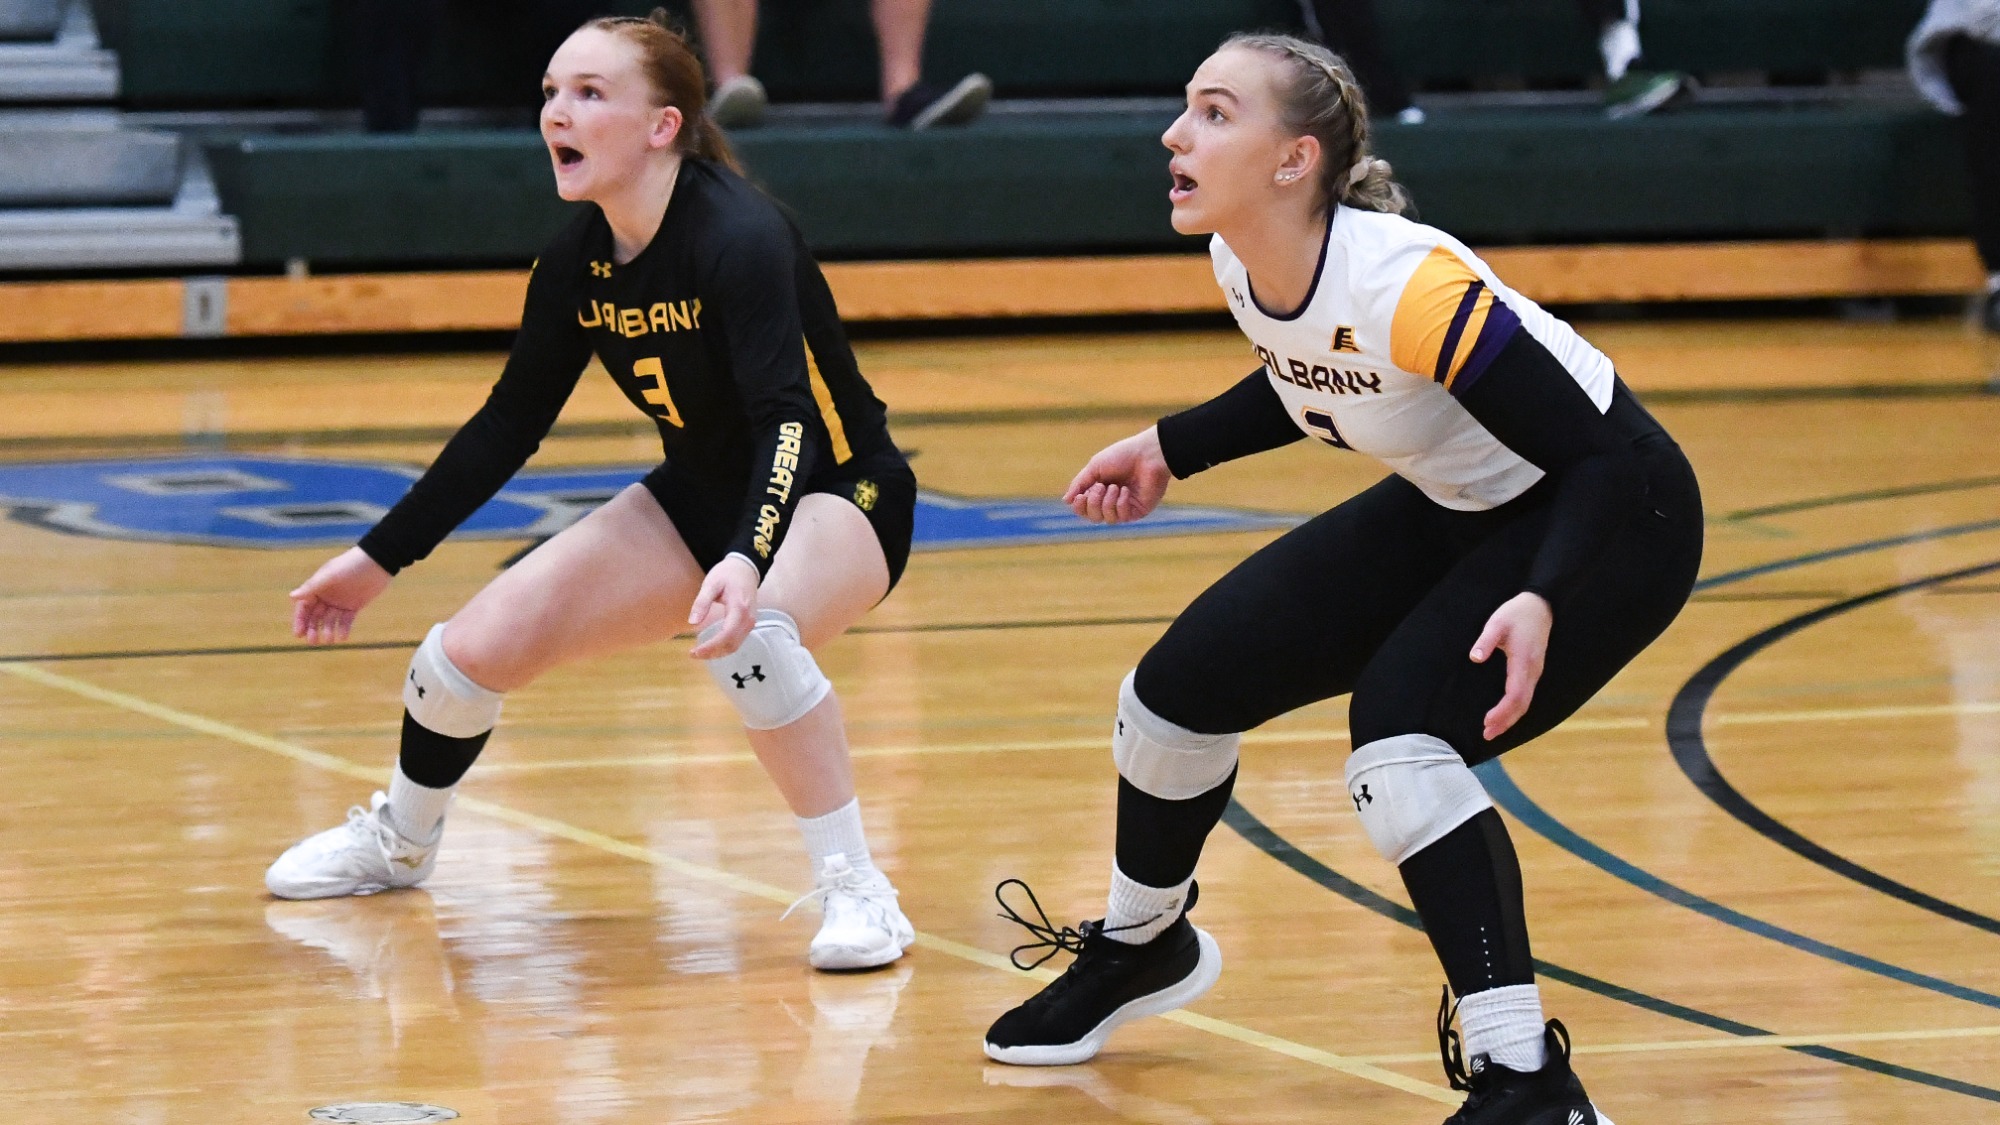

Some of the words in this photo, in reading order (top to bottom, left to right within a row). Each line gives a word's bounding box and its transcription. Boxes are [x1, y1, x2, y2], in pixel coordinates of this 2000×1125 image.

[633, 357, 684, 428] 3
[1252, 343, 1383, 396] ALBANY
[766, 421, 803, 505] GREAT
